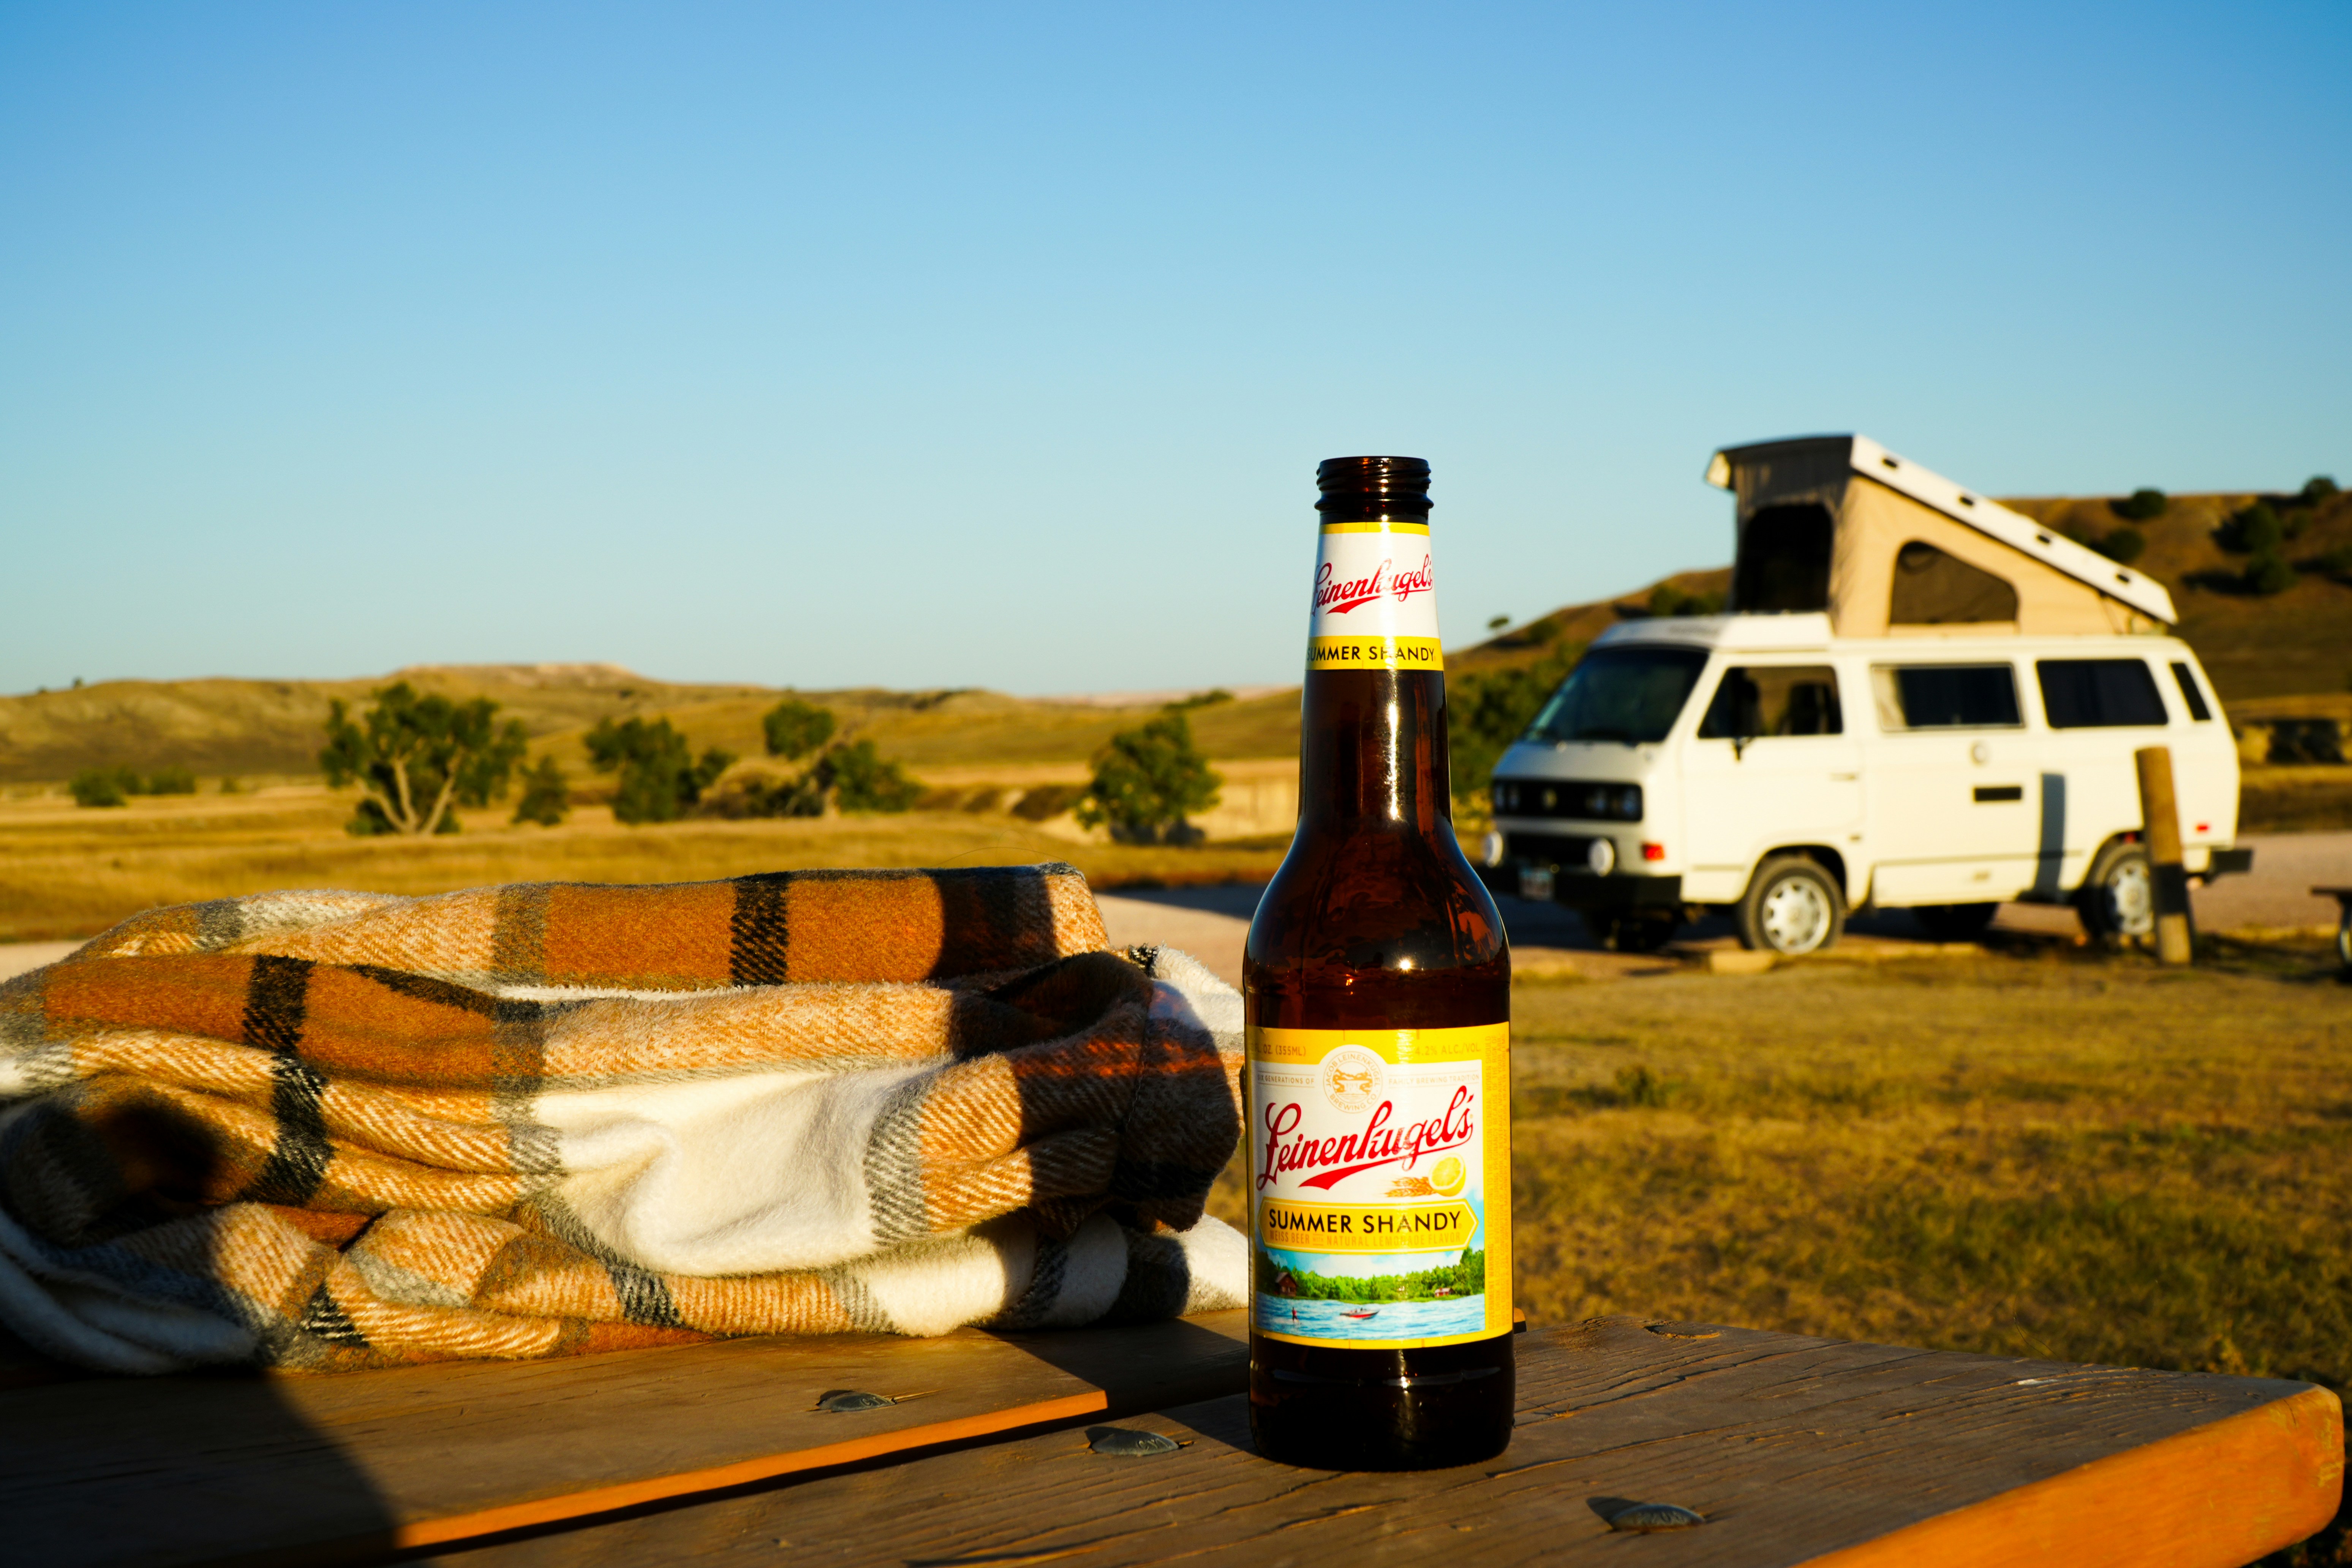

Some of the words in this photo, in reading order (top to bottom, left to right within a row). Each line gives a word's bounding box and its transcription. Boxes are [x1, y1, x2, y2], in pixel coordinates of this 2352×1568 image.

[1307, 646, 1361, 661] SUMMER
[1492, 1035, 1497, 1044] OF
[1264, 1044, 1272, 1054] OZ.
[1276, 1045, 1306, 1057] (355ML)
[1415, 1046, 1437, 1056] 4.2%
[1326, 1061, 1338, 1087] JACOB
[1337, 1054, 1380, 1086] LEINENKUGEL
[1266, 1075, 1303, 1084] GENERATIONS
[1492, 1082, 1498, 1091] OF
[1329, 1094, 1366, 1110] BREWING
[1256, 1086, 1474, 1190] Leinenkugel's
[1269, 1208, 1353, 1233] SUMMER
[1363, 1211, 1461, 1233] SHANDY
[1269, 1229, 1288, 1242] WEISS
[1291, 1233, 1309, 1244] BEER
[1327, 1236, 1369, 1246] NATURAL
[1374, 1234, 1424, 1246] LEMONADE
[1429, 1232, 1460, 1244] FLAVOR
